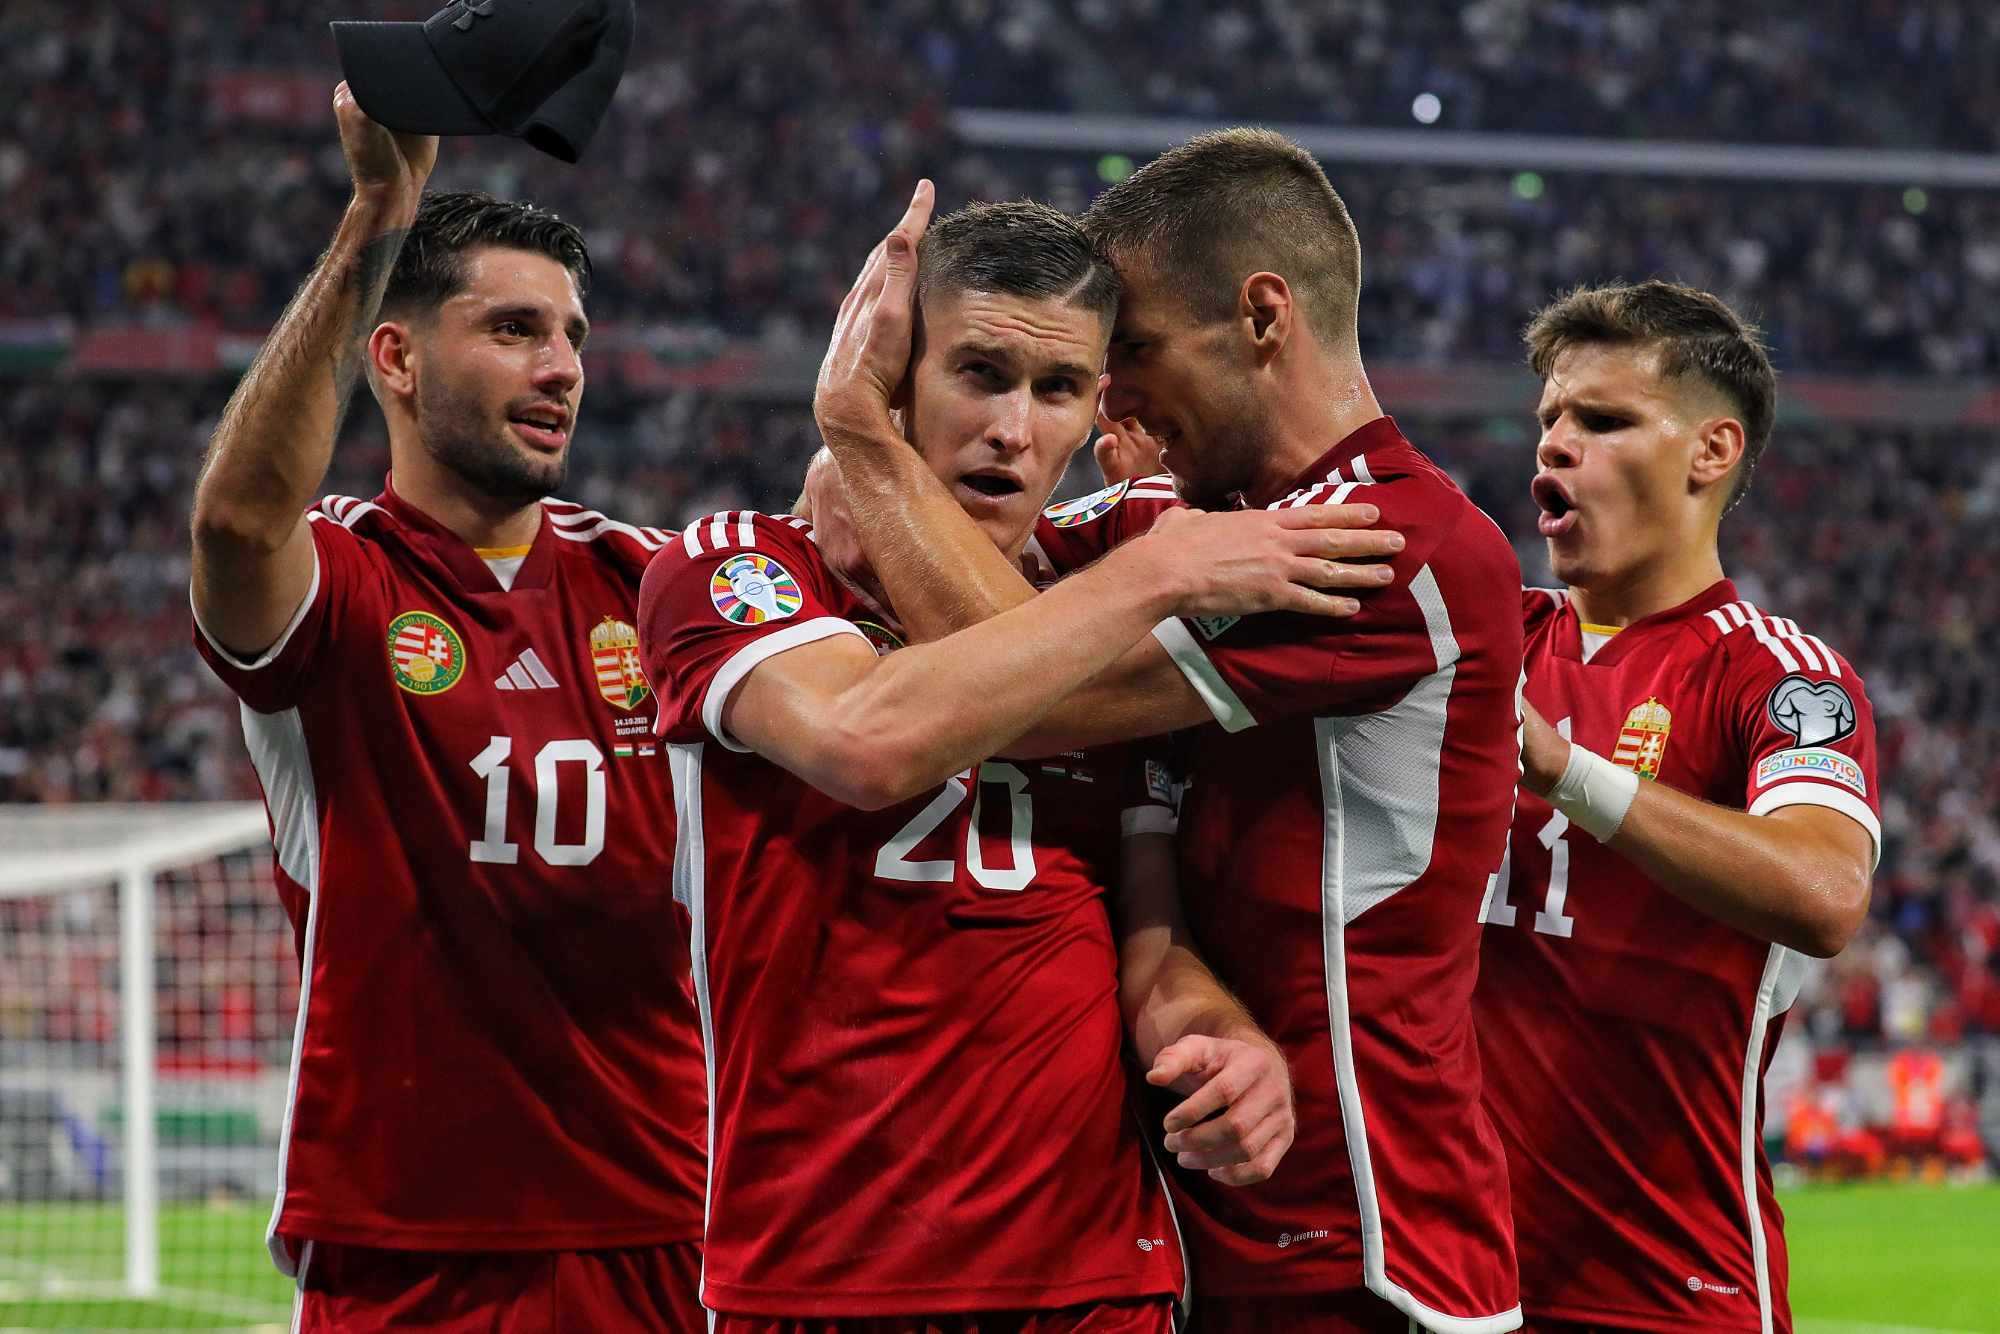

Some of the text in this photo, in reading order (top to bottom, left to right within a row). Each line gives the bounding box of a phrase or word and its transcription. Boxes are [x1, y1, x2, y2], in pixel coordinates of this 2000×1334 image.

[408, 681, 433, 691] 1901
[616, 726, 648, 736] BUDAPEST
[1759, 755, 1865, 787] FOUNDATION
[468, 735, 606, 866] 10
[874, 761, 1036, 891] 20
[1292, 1230, 1329, 1243] AEROREADY
